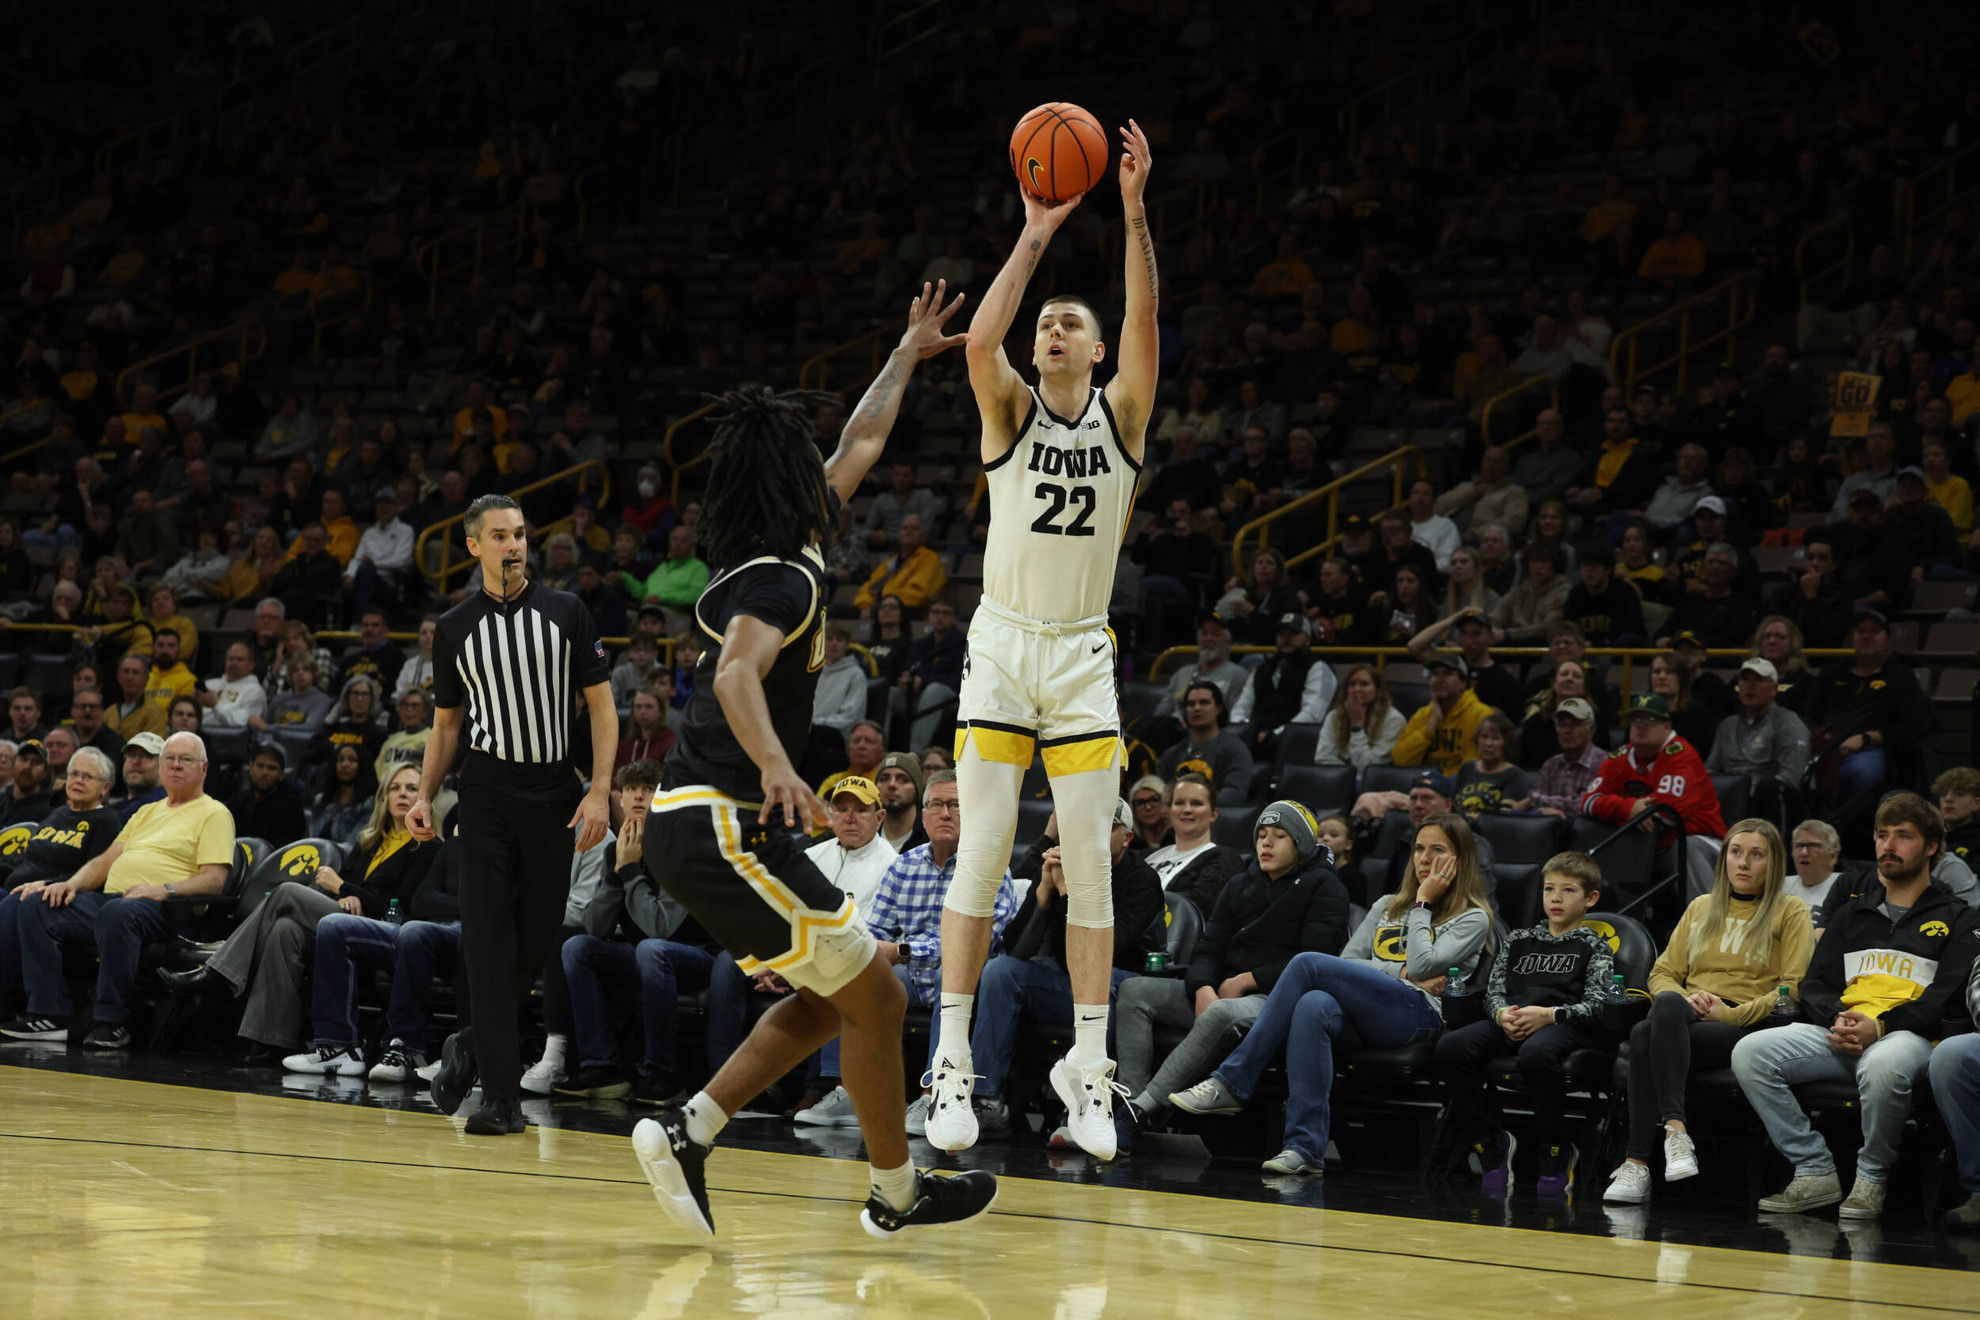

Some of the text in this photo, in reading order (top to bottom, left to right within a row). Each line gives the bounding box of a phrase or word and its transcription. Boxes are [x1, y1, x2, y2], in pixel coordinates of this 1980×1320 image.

[1841, 385, 1871, 404] GO
[1027, 441, 1111, 479] IOWA
[1031, 482, 1096, 536] 22
[1657, 773, 1686, 797] 98
[1512, 953, 1581, 975] IOWA
[1858, 952, 1914, 979] IOWA
